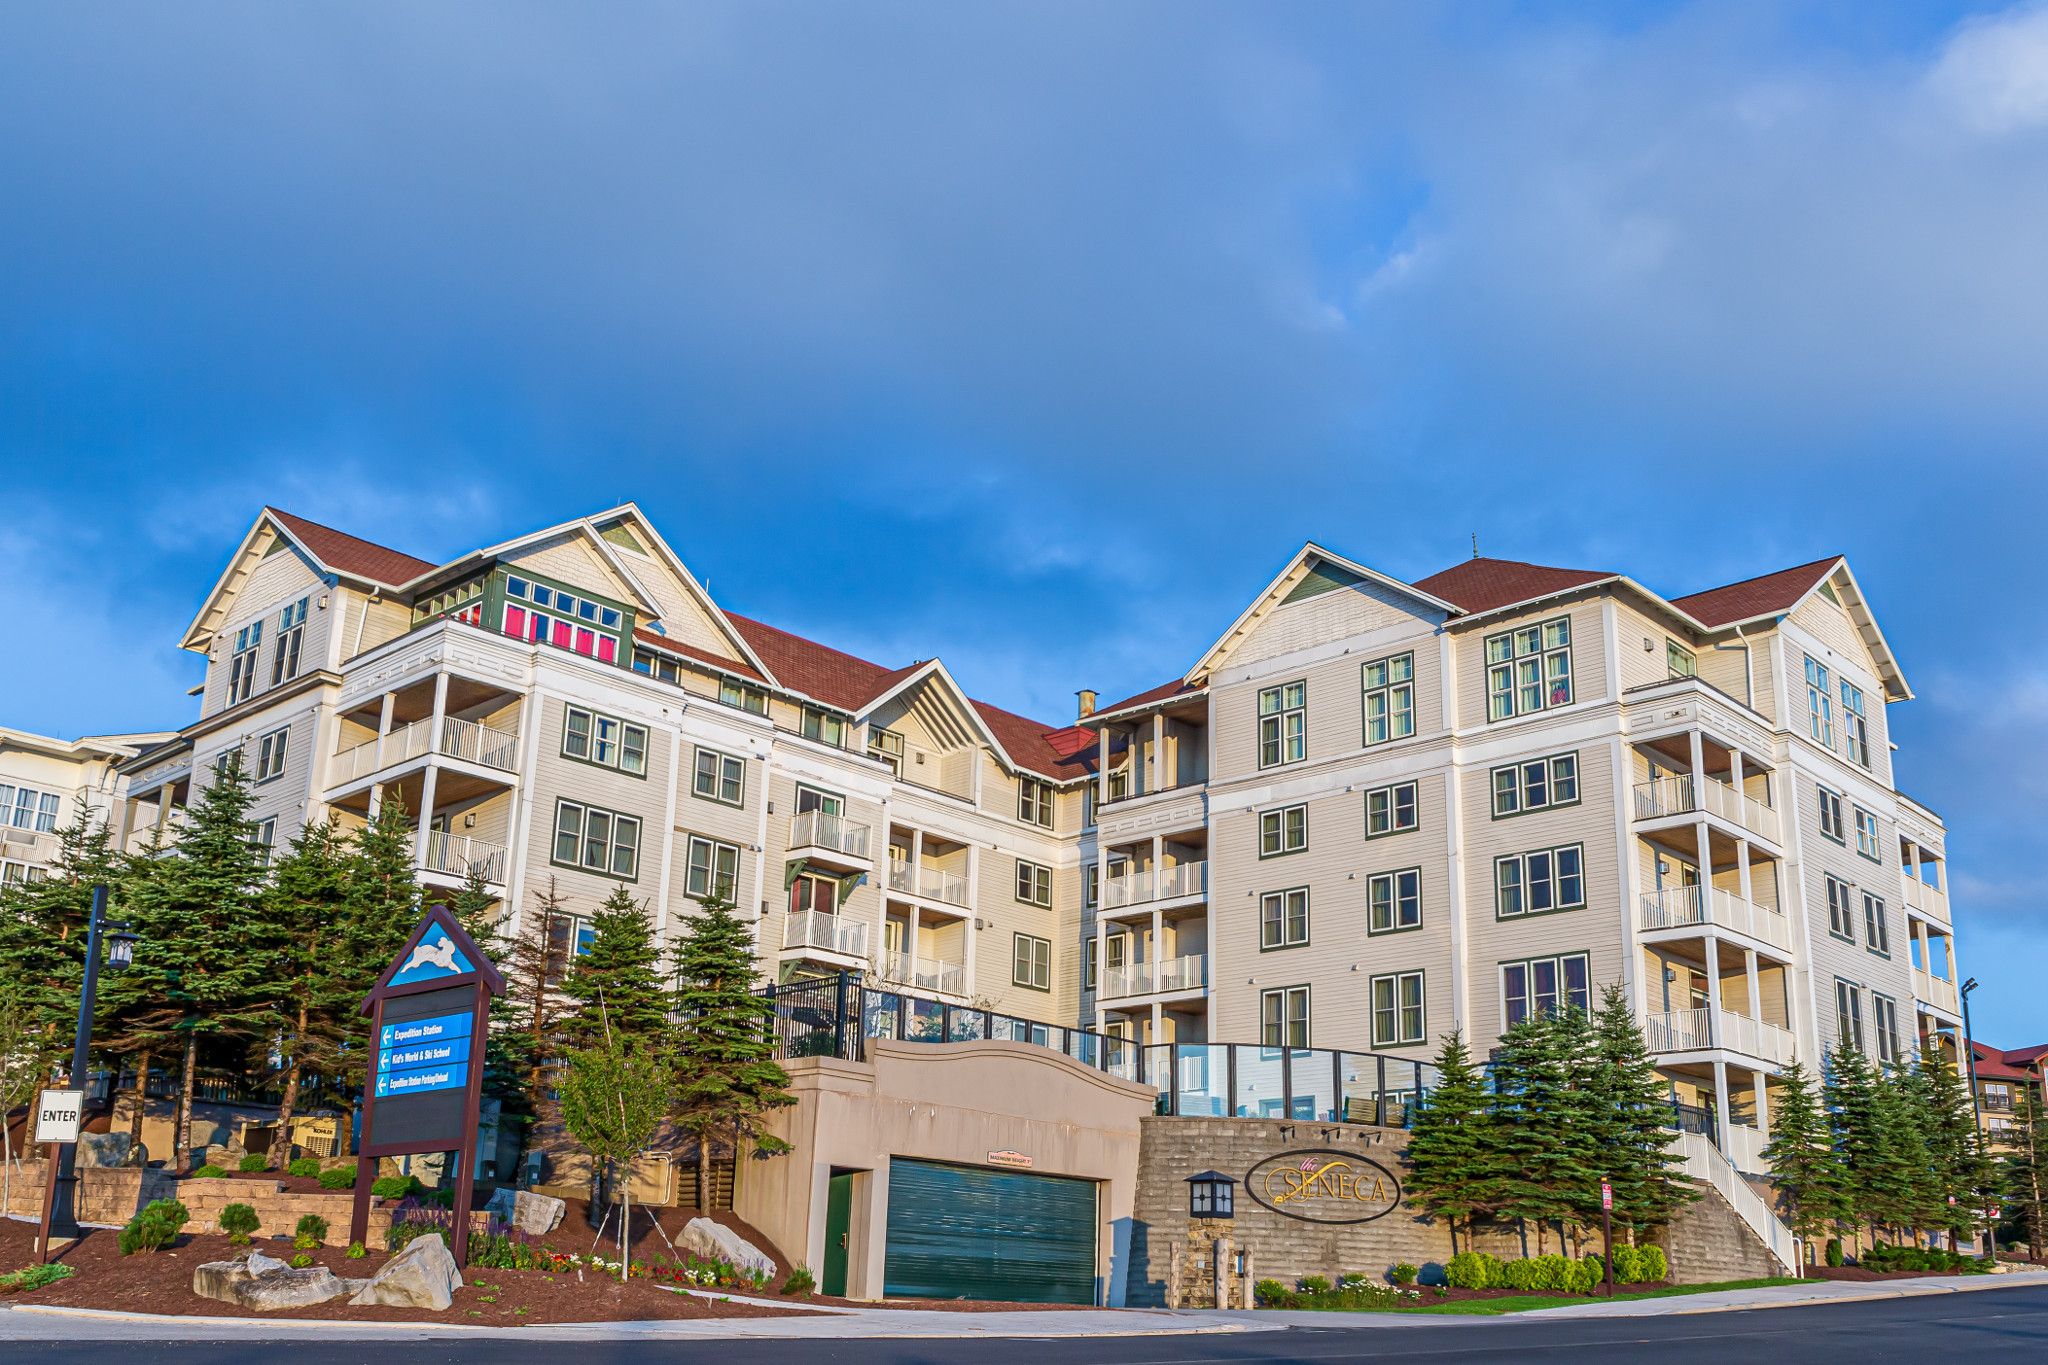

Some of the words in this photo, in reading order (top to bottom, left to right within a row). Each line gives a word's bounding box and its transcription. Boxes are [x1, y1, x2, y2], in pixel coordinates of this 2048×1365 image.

[395, 1028, 422, 1041] Expedition
[423, 1025, 443, 1036] Station
[392, 1054, 404, 1064] Kid's
[405, 1051, 419, 1062] World
[419, 1051, 424, 1061] &
[425, 1049, 433, 1060] Ski
[433, 1046, 450, 1058] School
[390, 1078, 408, 1090] Expedition
[409, 1076, 421, 1086] Station
[42, 1110, 77, 1122] ENTER
[1300, 1157, 1319, 1171] the
[1285, 1171, 1387, 1202] SENECA
